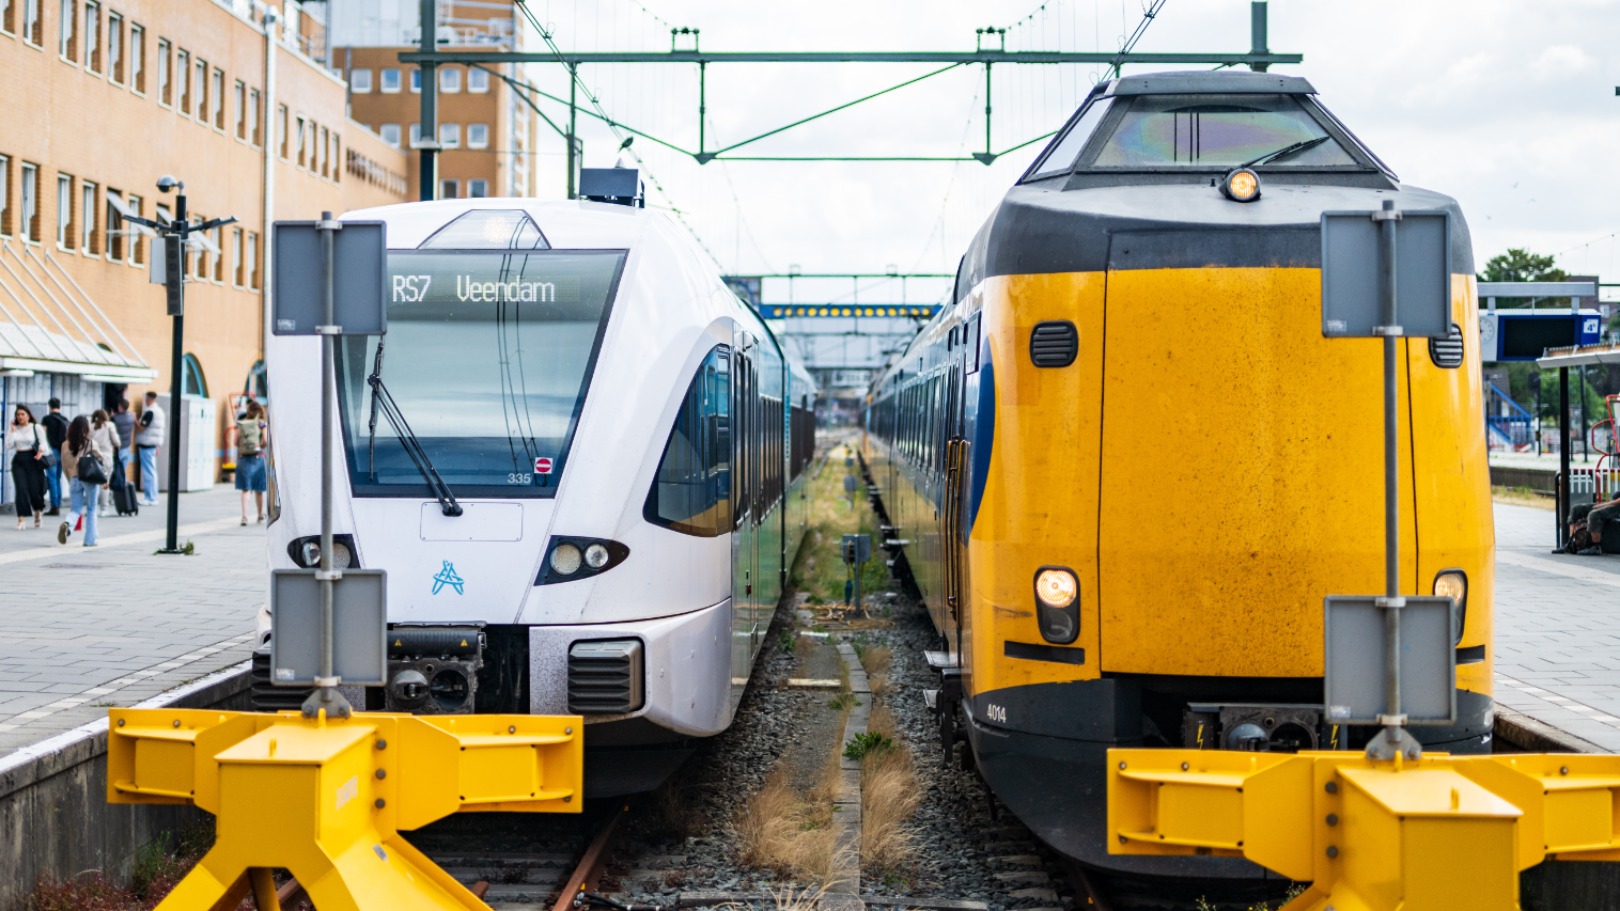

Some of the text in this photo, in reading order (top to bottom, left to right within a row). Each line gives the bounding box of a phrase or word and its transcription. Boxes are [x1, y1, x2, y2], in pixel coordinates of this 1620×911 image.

[392, 275, 555, 302] RS7 Veendam
[507, 473, 531, 484] 335
[987, 703, 1007, 723] 4014
